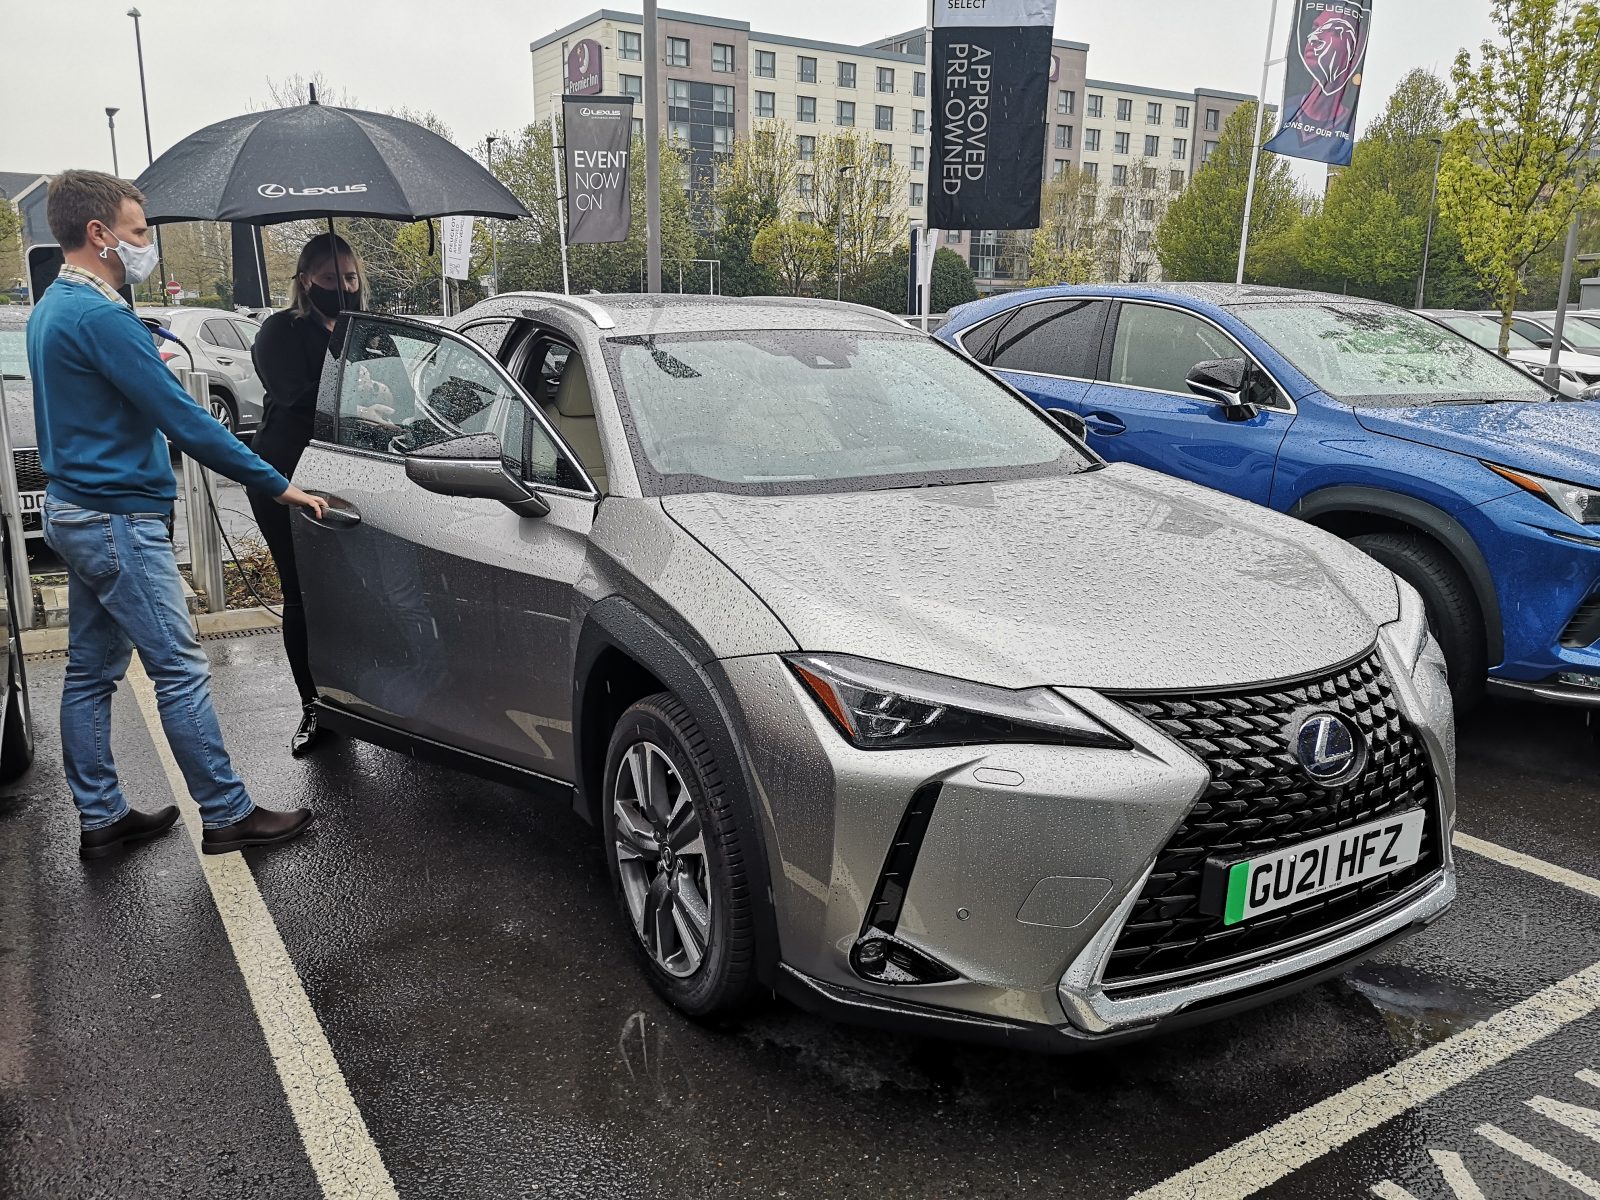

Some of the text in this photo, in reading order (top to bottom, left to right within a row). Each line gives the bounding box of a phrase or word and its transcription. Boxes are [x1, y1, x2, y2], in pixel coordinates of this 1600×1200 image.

[947, 0, 986, 9] SELECT
[1305, 2, 1364, 22] PEUGEOT
[569, 73, 599, 93] Premier Inn
[942, 43, 969, 195] PRE-OWNED
[965, 44, 992, 181] APPROVED
[1303, 124, 1316, 133] OF
[1315, 127, 1332, 138] OUR
[574, 150, 628, 168] EVENT
[288, 183, 368, 195] LEXUS
[575, 172, 620, 190] NOW
[575, 193, 603, 211] ON
[1249, 822, 1404, 909] GU21 HFZ
